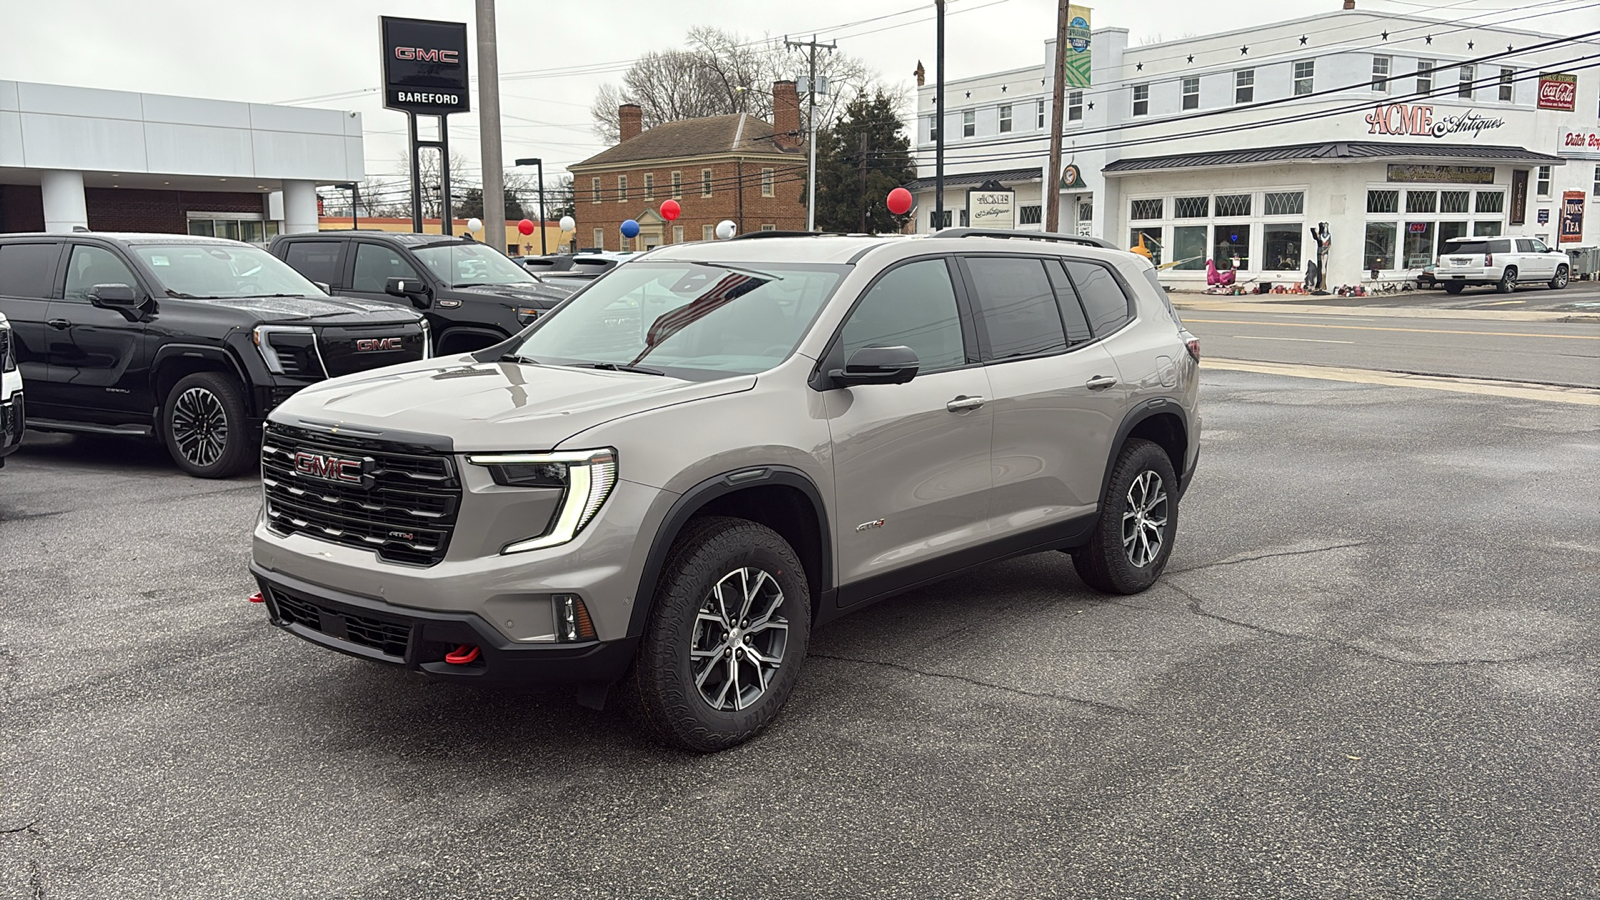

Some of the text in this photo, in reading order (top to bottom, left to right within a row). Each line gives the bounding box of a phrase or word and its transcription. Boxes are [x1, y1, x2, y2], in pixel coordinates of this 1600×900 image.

[395, 46, 459, 63] GMC
[398, 92, 458, 104] BAREFORD
[1365, 103, 1506, 138] ACME Antiques
[1565, 132, 1586, 147] Dutch
[977, 194, 1009, 205] ACME
[1565, 219, 1579, 233] TEA
[356, 337, 402, 351] GMC
[294, 451, 362, 483] GMC
[855, 517, 885, 533] AT4
[389, 530, 414, 541] AT4
